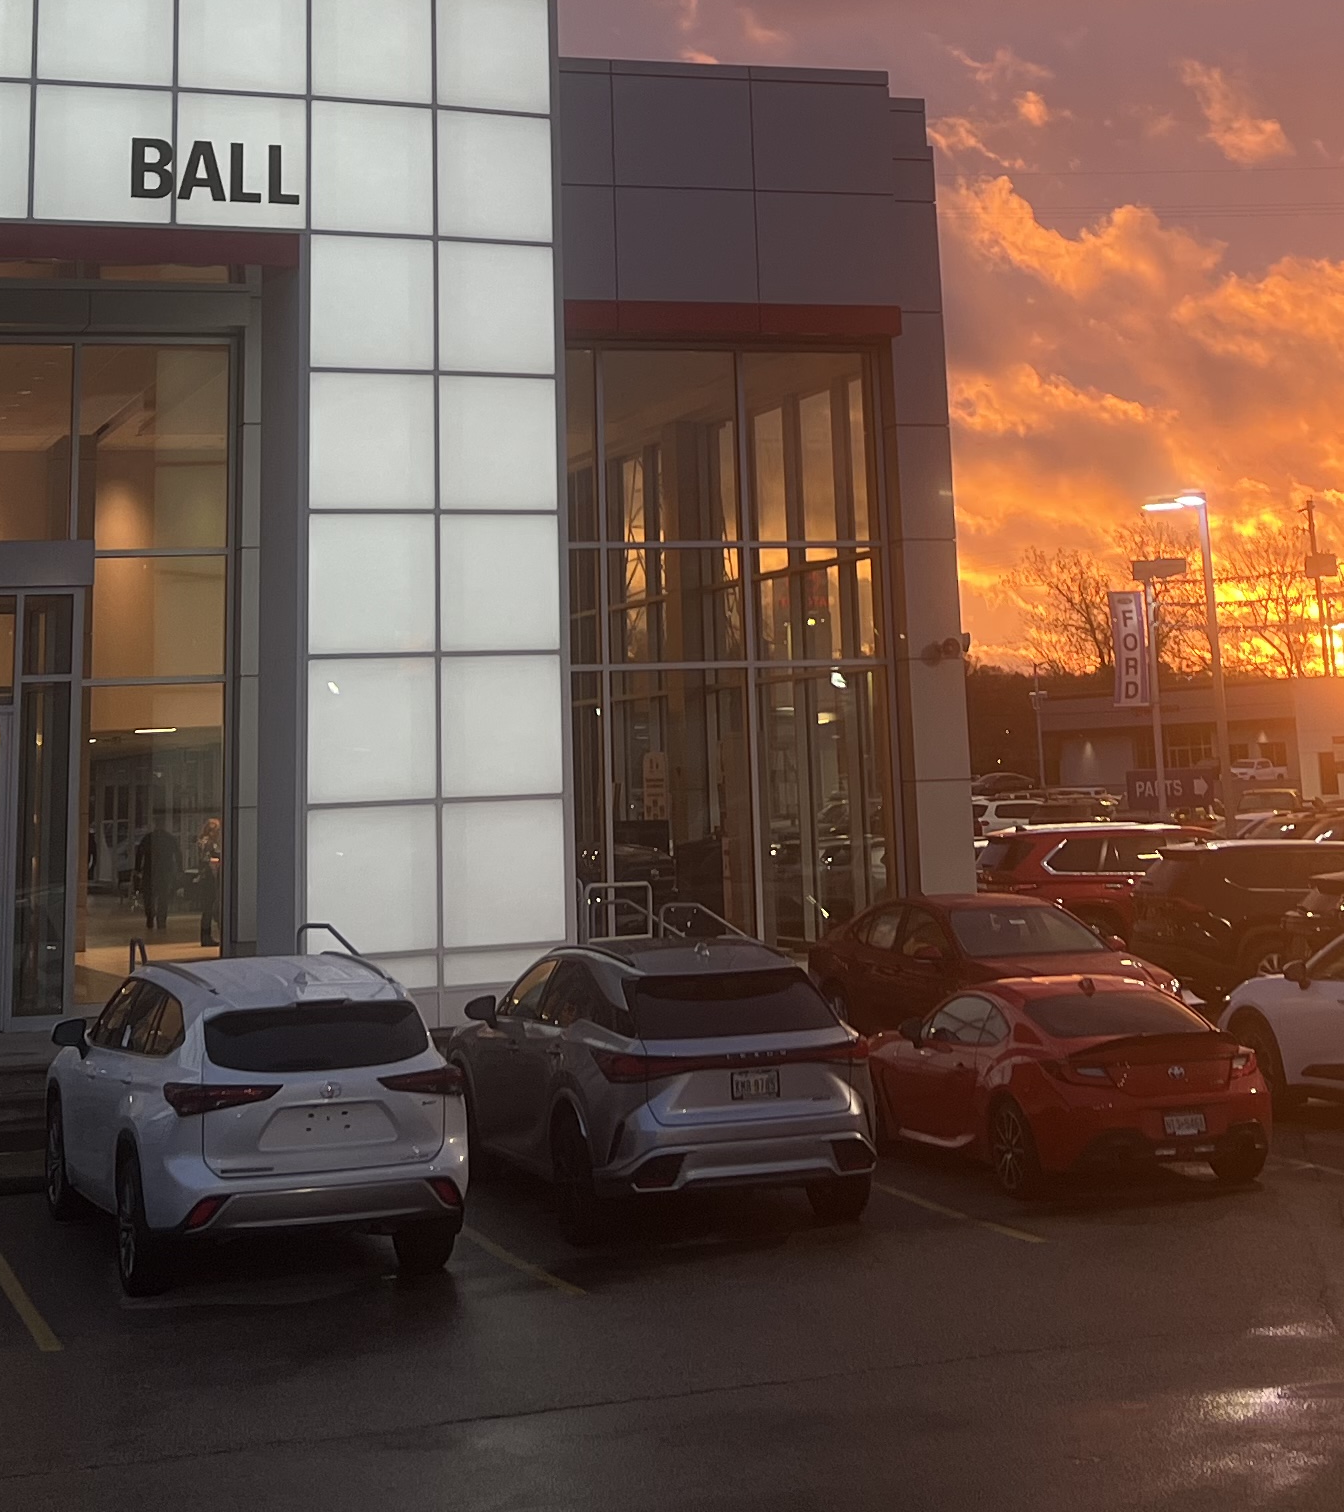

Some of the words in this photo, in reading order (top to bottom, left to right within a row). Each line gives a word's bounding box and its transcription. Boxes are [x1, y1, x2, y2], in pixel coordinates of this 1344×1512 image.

[130, 136, 300, 205] BALL
[1121, 609, 1139, 699] FORD
[1136, 779, 1183, 798] PATS
